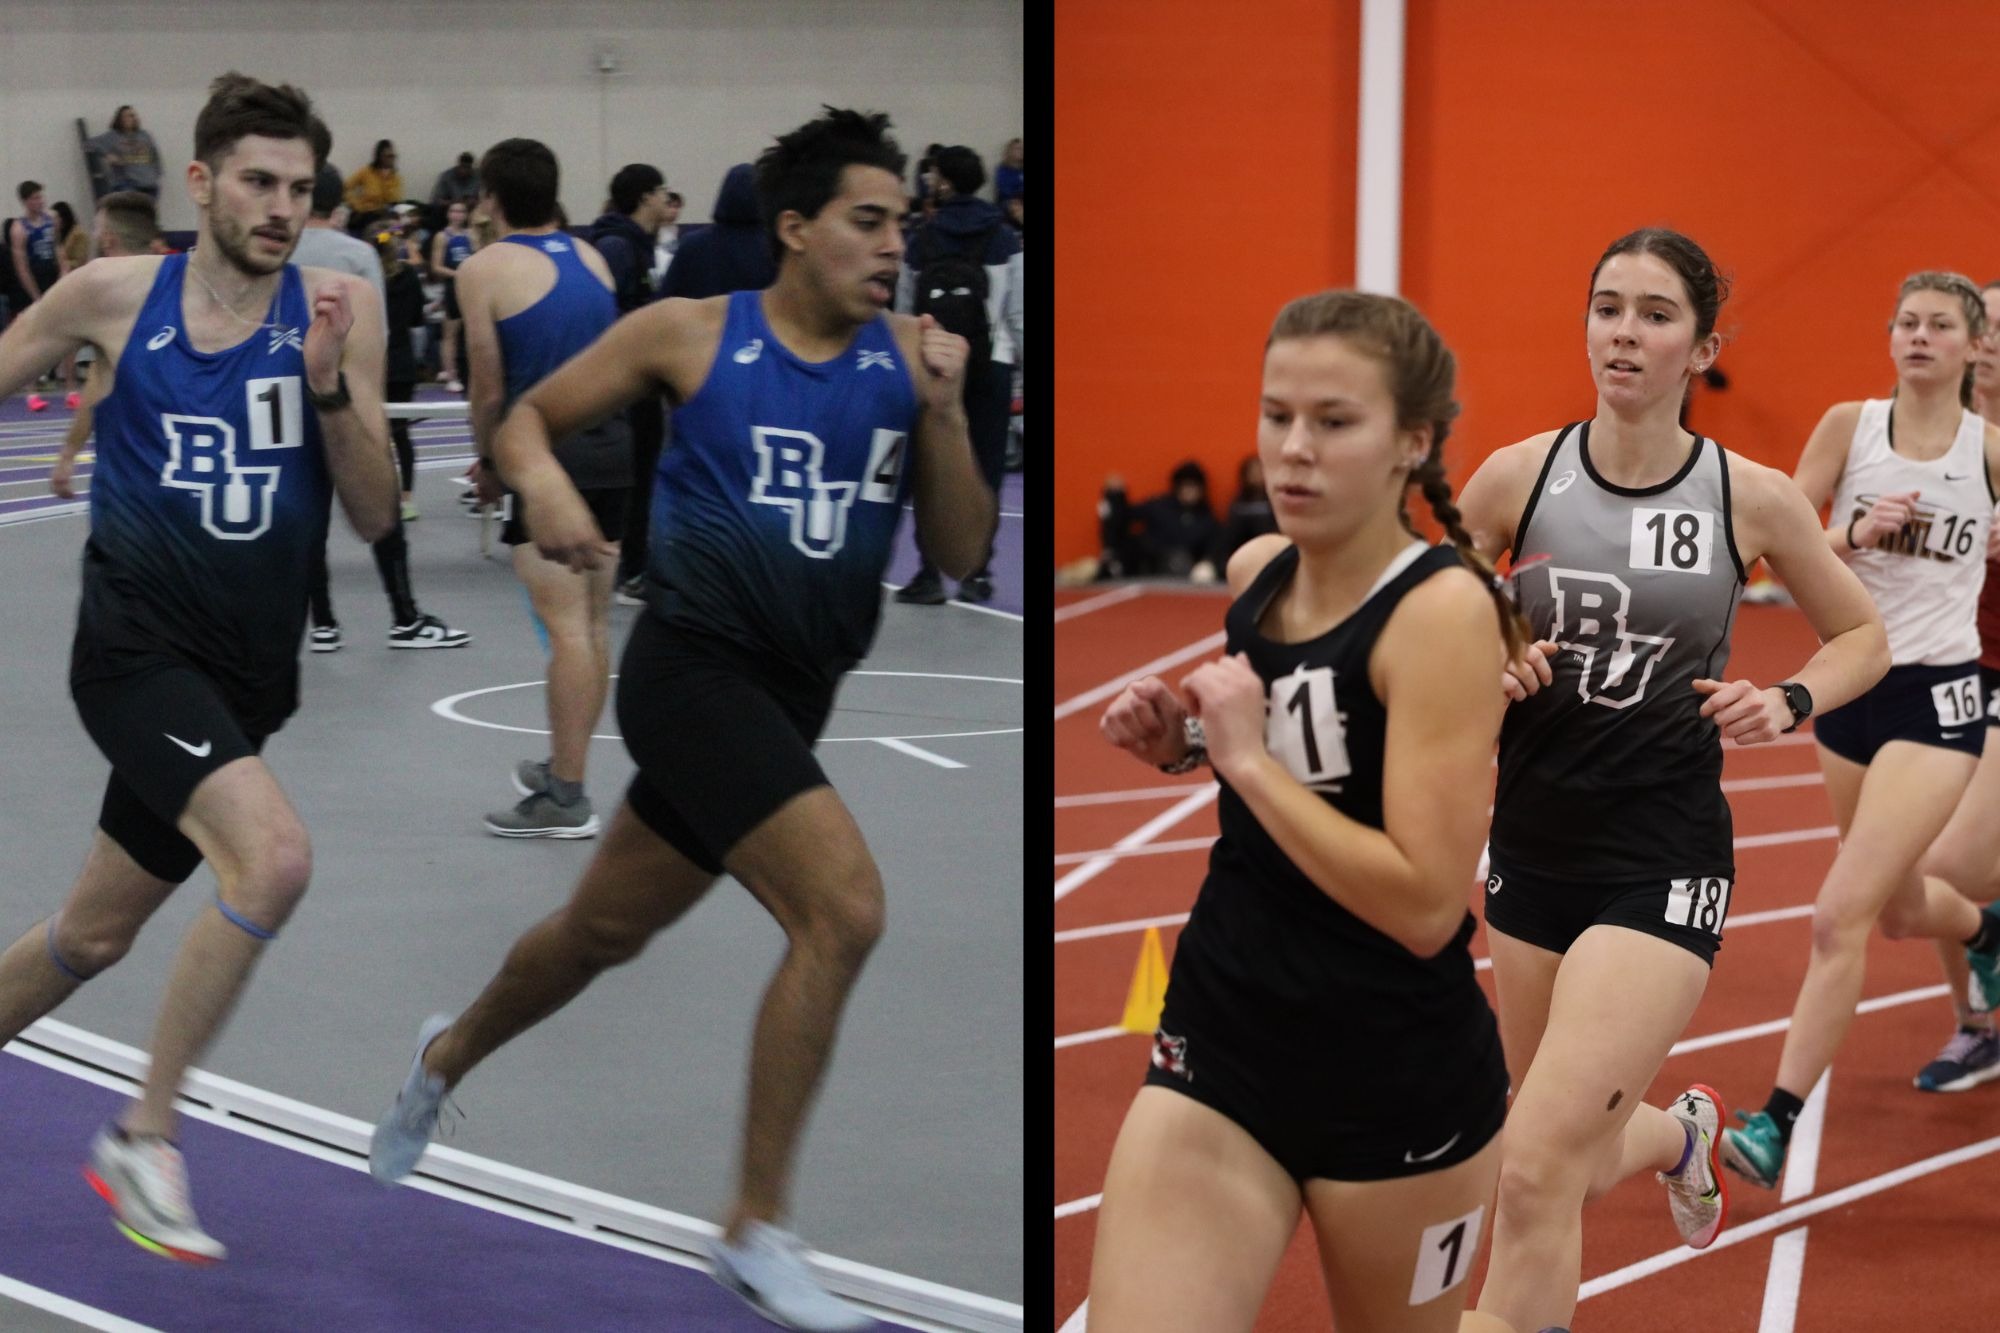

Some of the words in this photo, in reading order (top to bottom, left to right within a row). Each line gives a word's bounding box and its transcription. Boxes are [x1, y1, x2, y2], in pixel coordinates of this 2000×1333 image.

[256, 382, 284, 445] 1
[160, 412, 283, 541] BU
[748, 424, 861, 560] BU
[1645, 512, 1700, 570] 18
[1943, 514, 1977, 556] 16
[1548, 567, 1676, 710] BU
[1287, 680, 1323, 774] 1
[1944, 680, 1975, 721] 16
[1685, 878, 1721, 933] 18
[1438, 1221, 1466, 1289] 1
